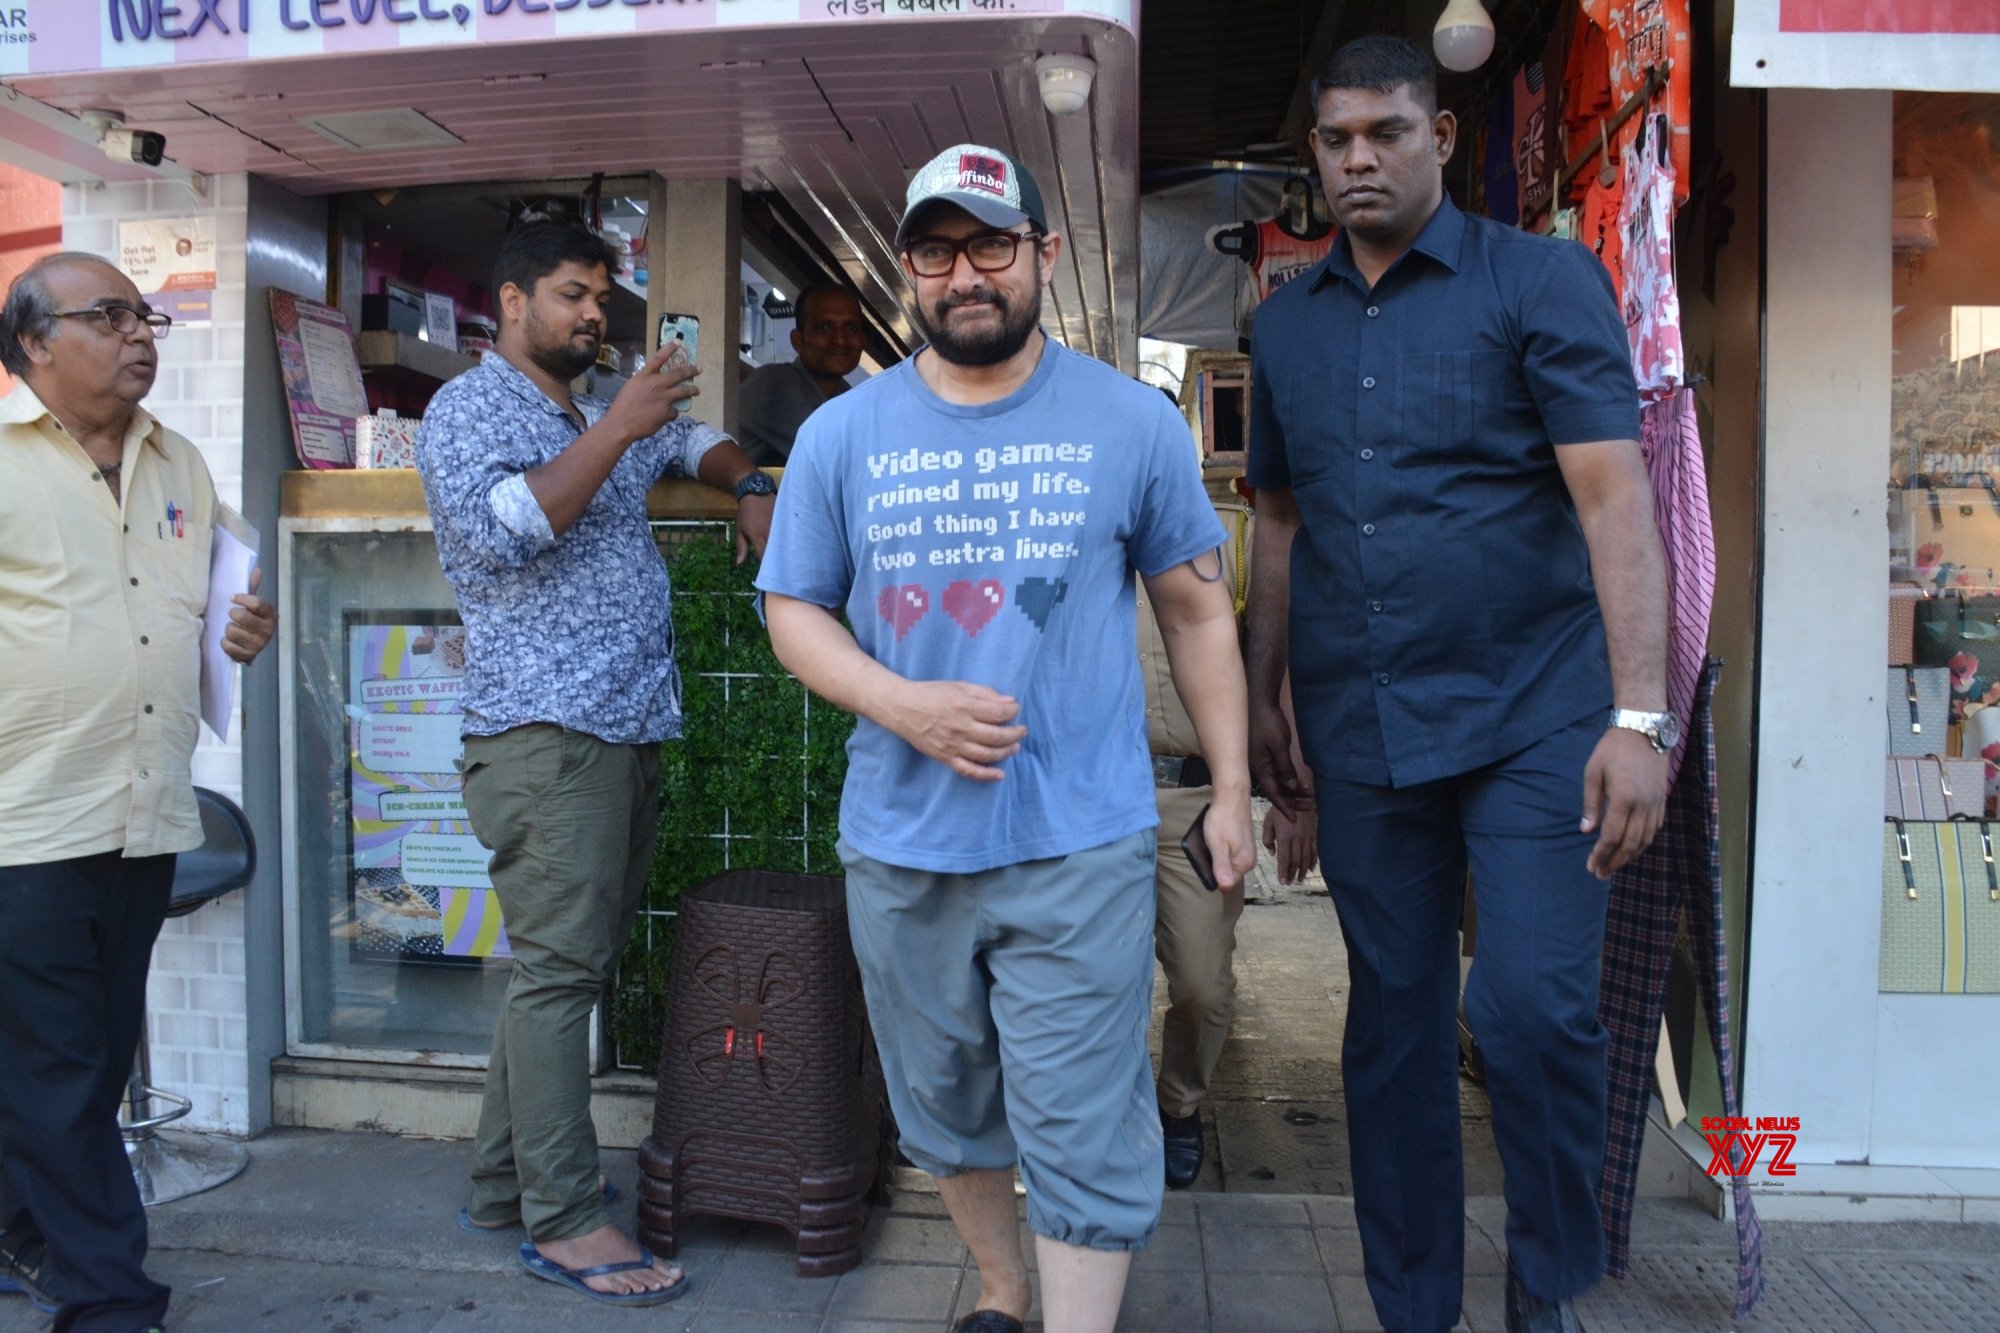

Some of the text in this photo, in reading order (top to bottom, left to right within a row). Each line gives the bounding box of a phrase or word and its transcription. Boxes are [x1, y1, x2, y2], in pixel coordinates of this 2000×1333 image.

[867, 443, 1093, 479] Video games
[867, 472, 1091, 512] ruined my life.
[867, 508, 1086, 543] Good thing I have
[872, 550, 916, 572] two
[928, 542, 1004, 566] extra
[366, 684, 414, 698] EXOTIC
[394, 725, 413, 733] OREO
[386, 801, 446, 811] ICE-CREAM
